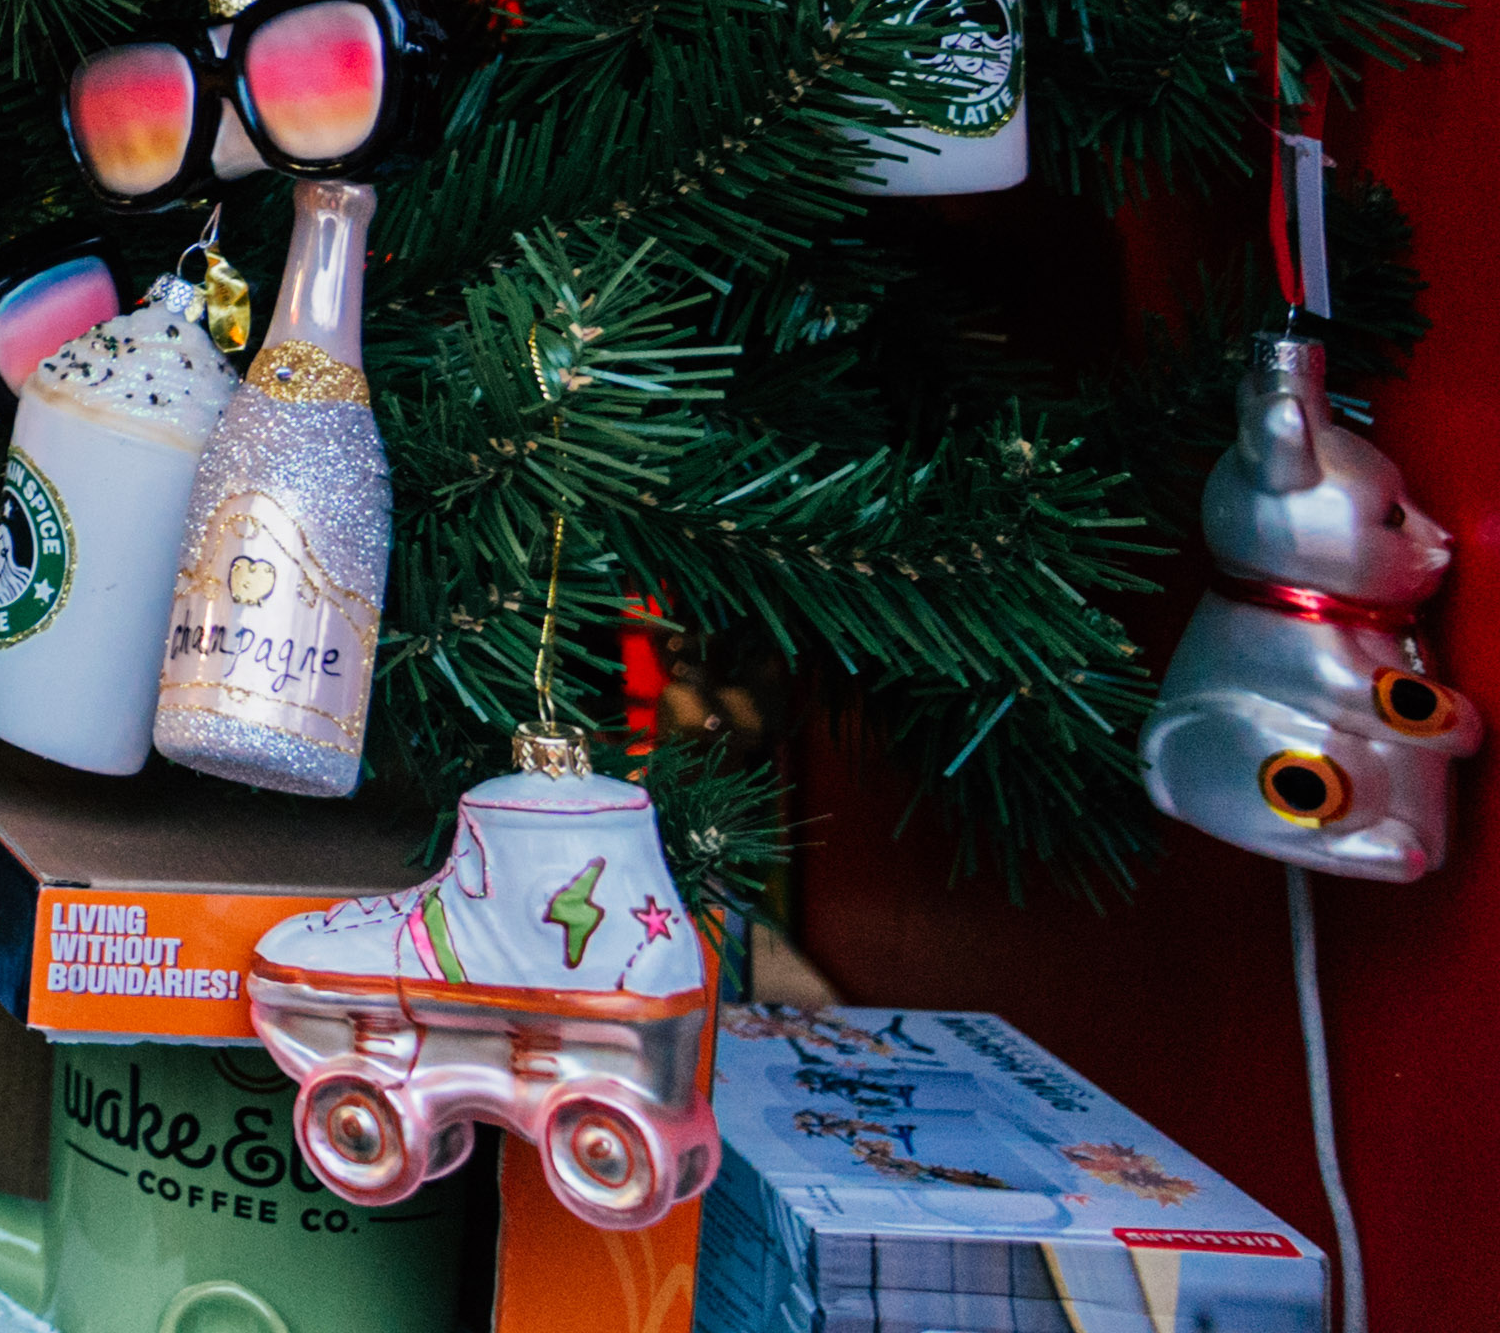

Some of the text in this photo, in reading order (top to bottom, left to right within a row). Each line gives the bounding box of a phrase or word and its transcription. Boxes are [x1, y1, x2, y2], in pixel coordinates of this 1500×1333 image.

[947, 85, 1014, 126] LATTE
[22, 479, 62, 556] SPICE
[169, 608, 342, 693] champagne
[51, 902, 147, 935] LIVING
[50, 933, 182, 967] WITHOUT
[47, 962, 241, 1001] BOUNDARIES!
[63, 1062, 218, 1170] wake
[137, 1168, 361, 1235] COFFEE CO.
